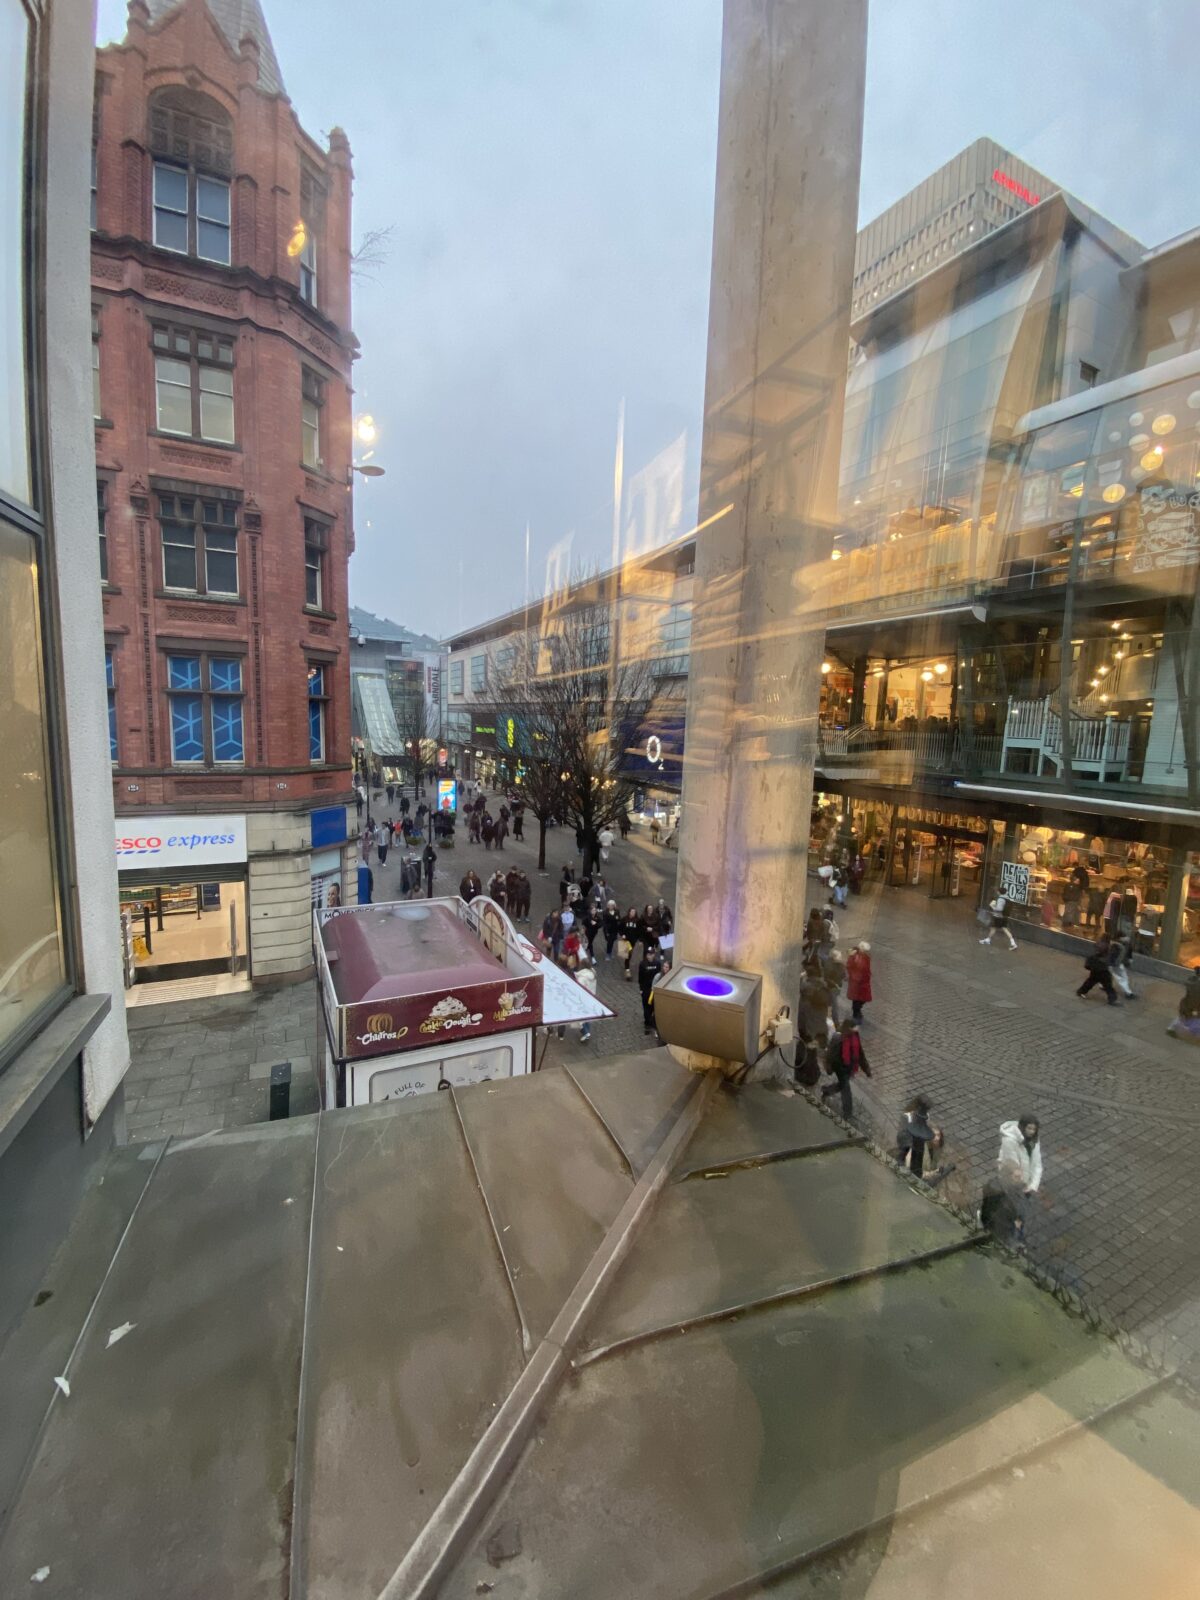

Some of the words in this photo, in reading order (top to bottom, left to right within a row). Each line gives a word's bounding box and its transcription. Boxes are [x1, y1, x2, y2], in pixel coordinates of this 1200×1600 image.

[431, 665, 440, 705] ARNDALE
[115, 837, 162, 850] ESCO
[167, 834, 235, 850] express
[419, 1019, 444, 1033] Cookie
[443, 1013, 472, 1030] Dough
[356, 1030, 398, 1045] Churros
[394, 1082, 412, 1096] FULL
[414, 1081, 426, 1089] OF
